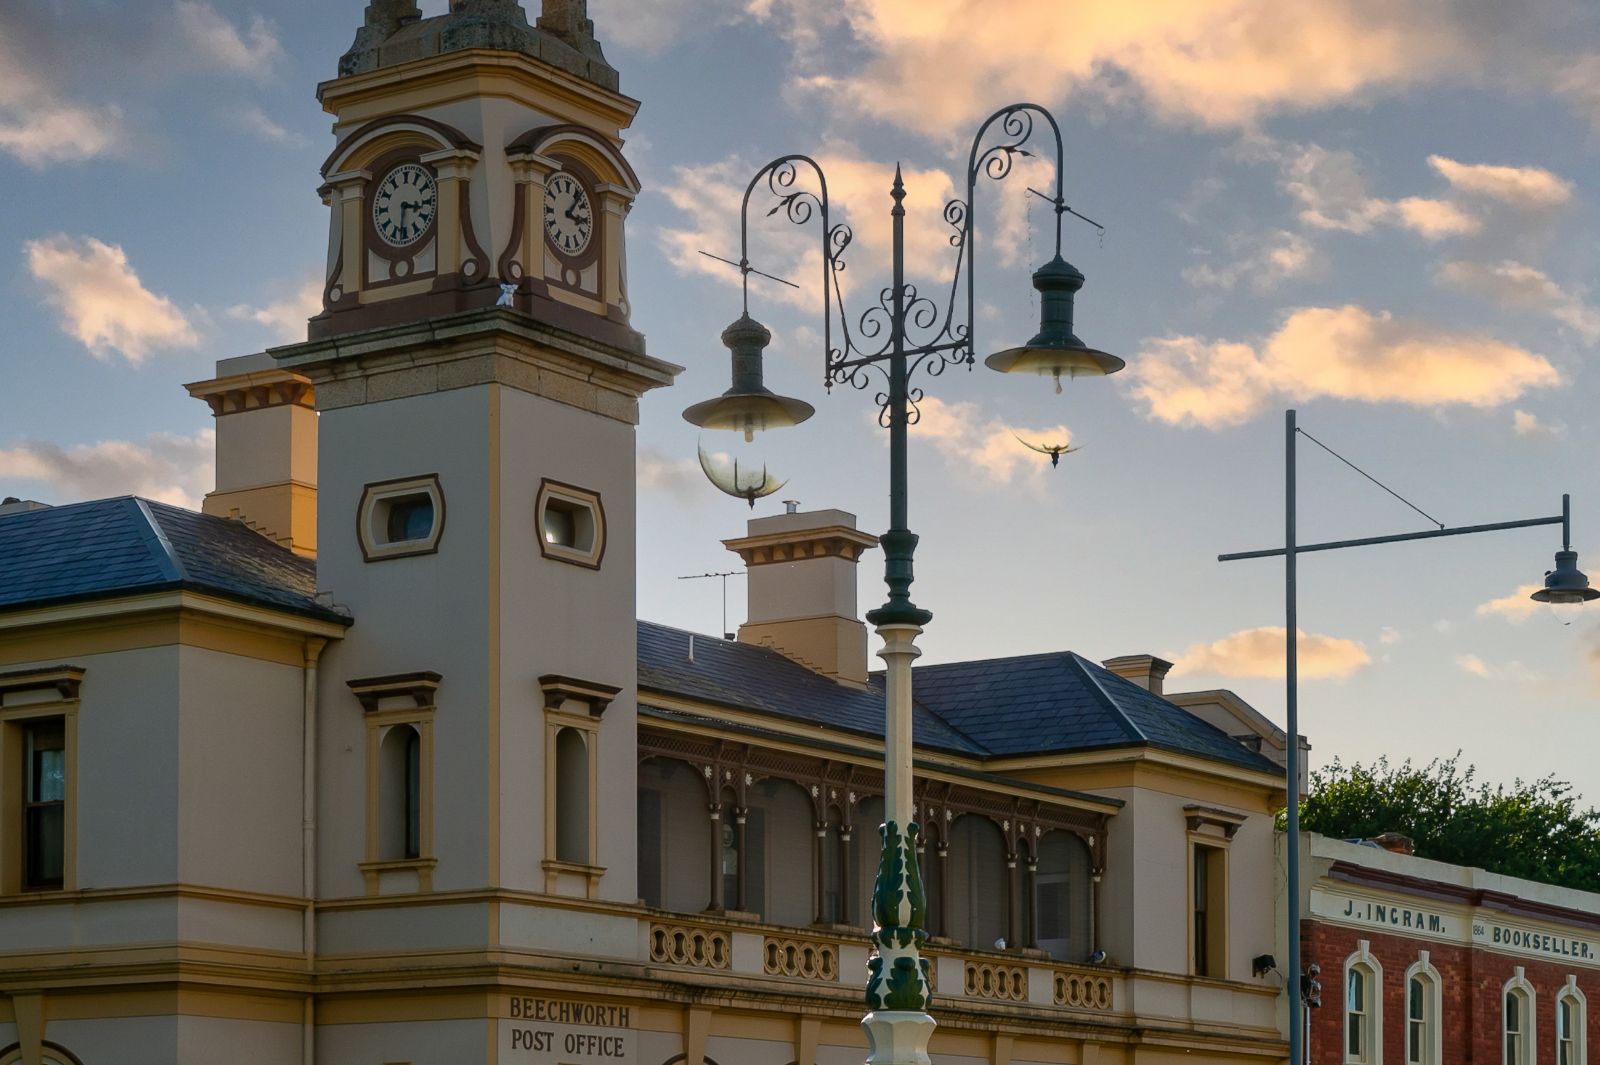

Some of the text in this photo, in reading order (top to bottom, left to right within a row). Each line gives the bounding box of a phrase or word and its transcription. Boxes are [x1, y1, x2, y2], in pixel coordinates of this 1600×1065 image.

[510, 997, 630, 1027] BEECHWORTH
[511, 1029, 625, 1057] POST OFFICE
